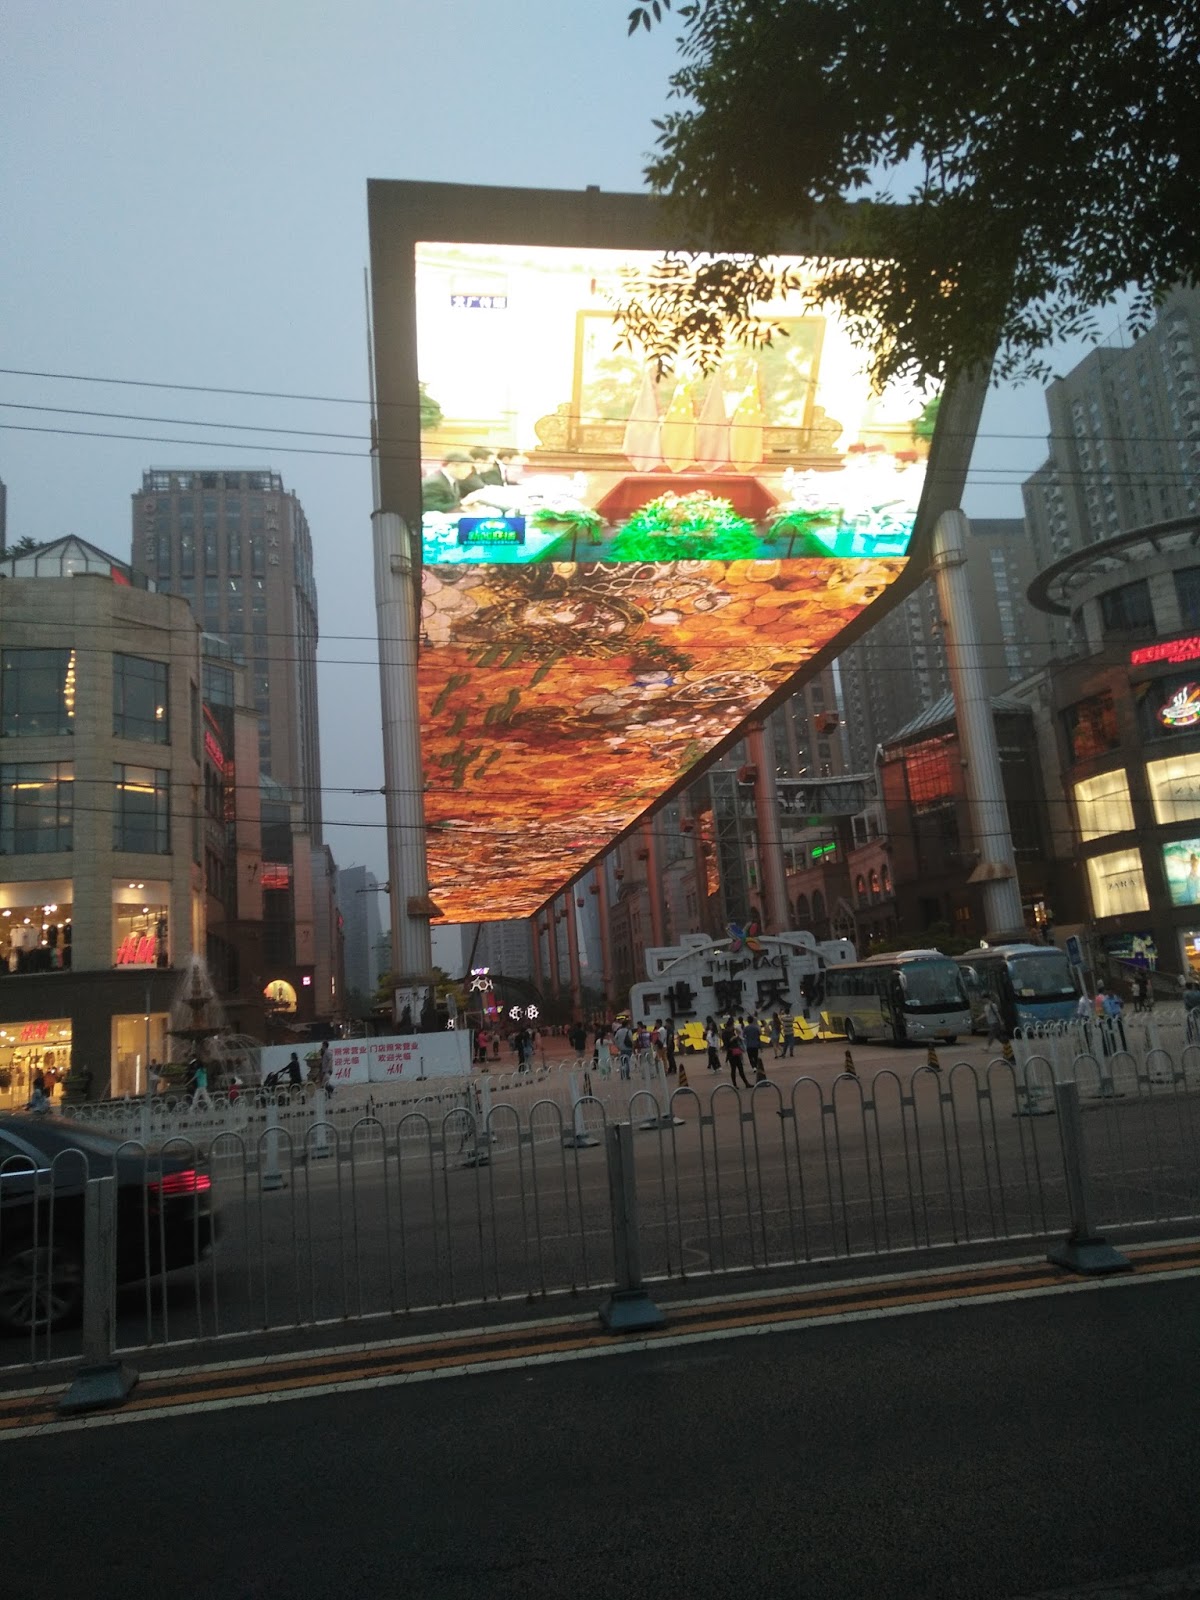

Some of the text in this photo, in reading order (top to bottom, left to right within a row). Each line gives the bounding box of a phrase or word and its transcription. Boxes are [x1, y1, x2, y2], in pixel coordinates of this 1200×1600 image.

[706, 954, 790, 973] THE PLACE
[332, 1046, 367, 1056] 照常营业
[370, 1042, 418, 1052] 门店照常营业
[335, 1057, 360, 1066] 迎光临
[378, 1053, 411, 1062] 欢迎光临
